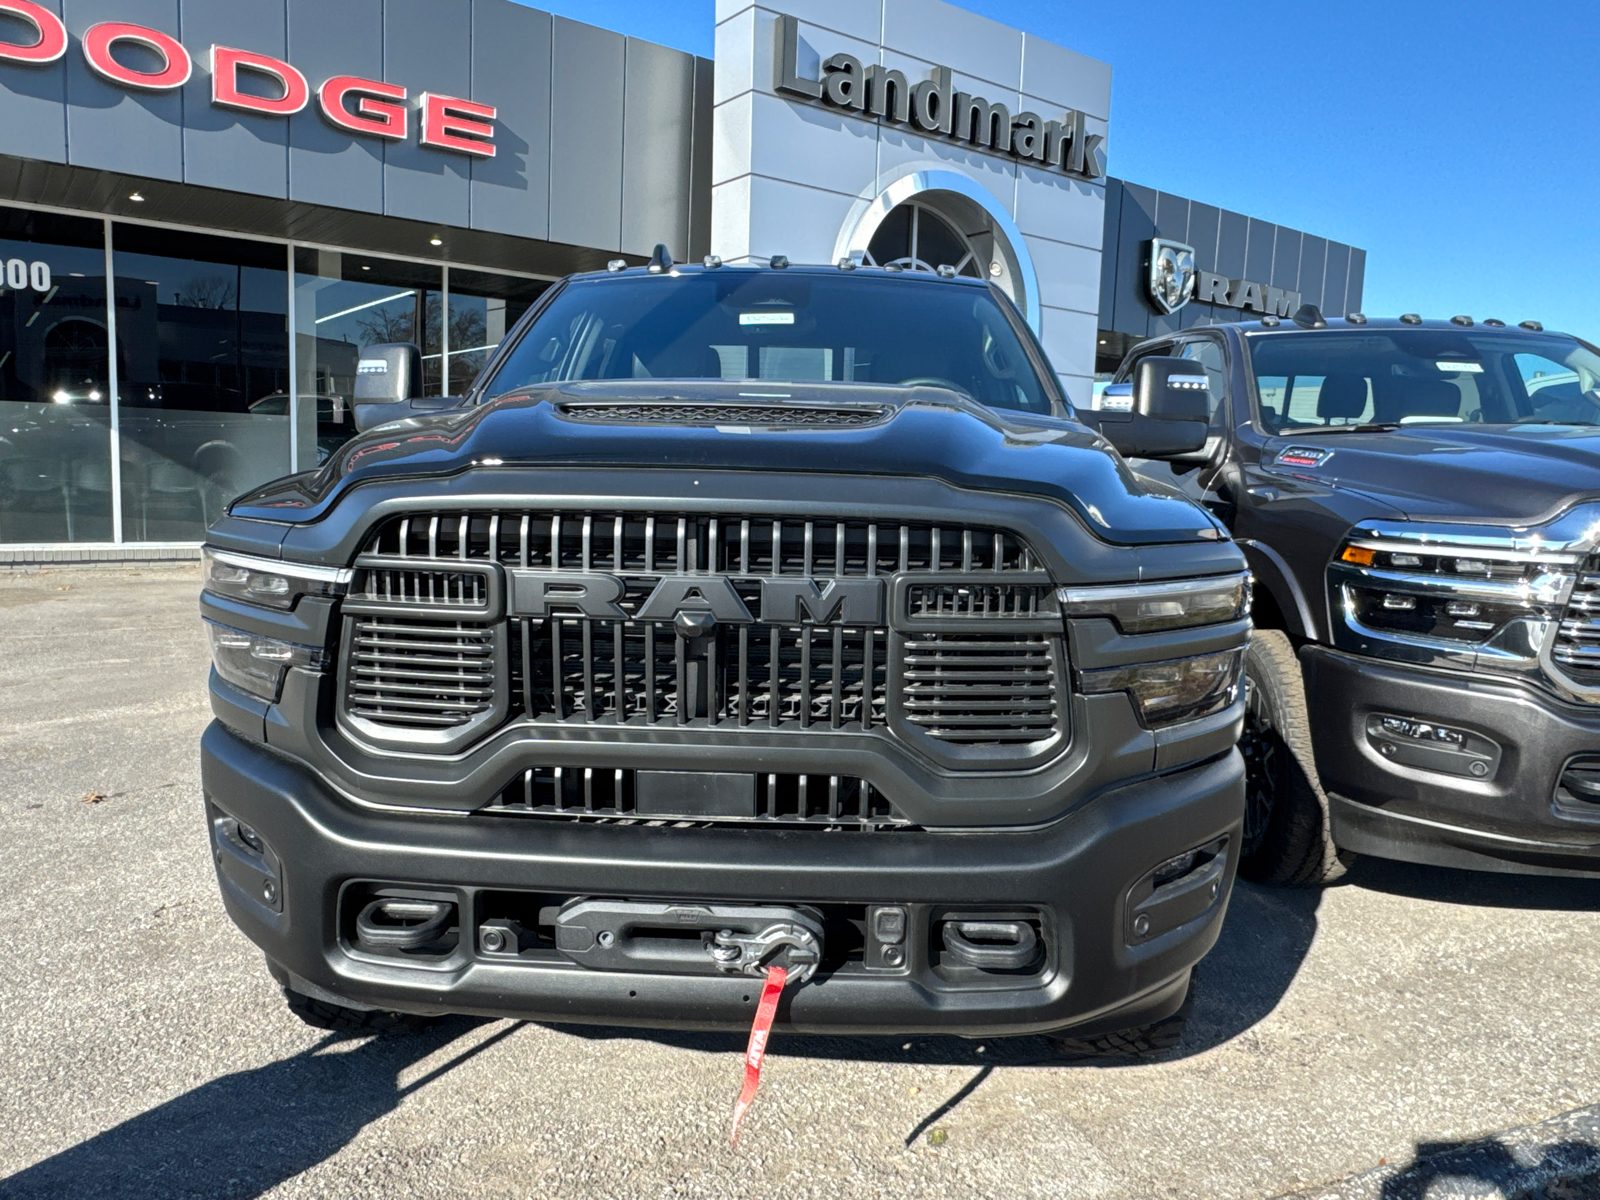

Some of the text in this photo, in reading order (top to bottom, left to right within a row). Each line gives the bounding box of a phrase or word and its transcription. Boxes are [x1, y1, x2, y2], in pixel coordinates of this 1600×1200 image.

[0, 0, 498, 159] DODGE
[773, 13, 1106, 178] Landmark
[0, 258, 51, 292] 00
[1197, 269, 1302, 319] RAM
[510, 568, 887, 626] RAM
